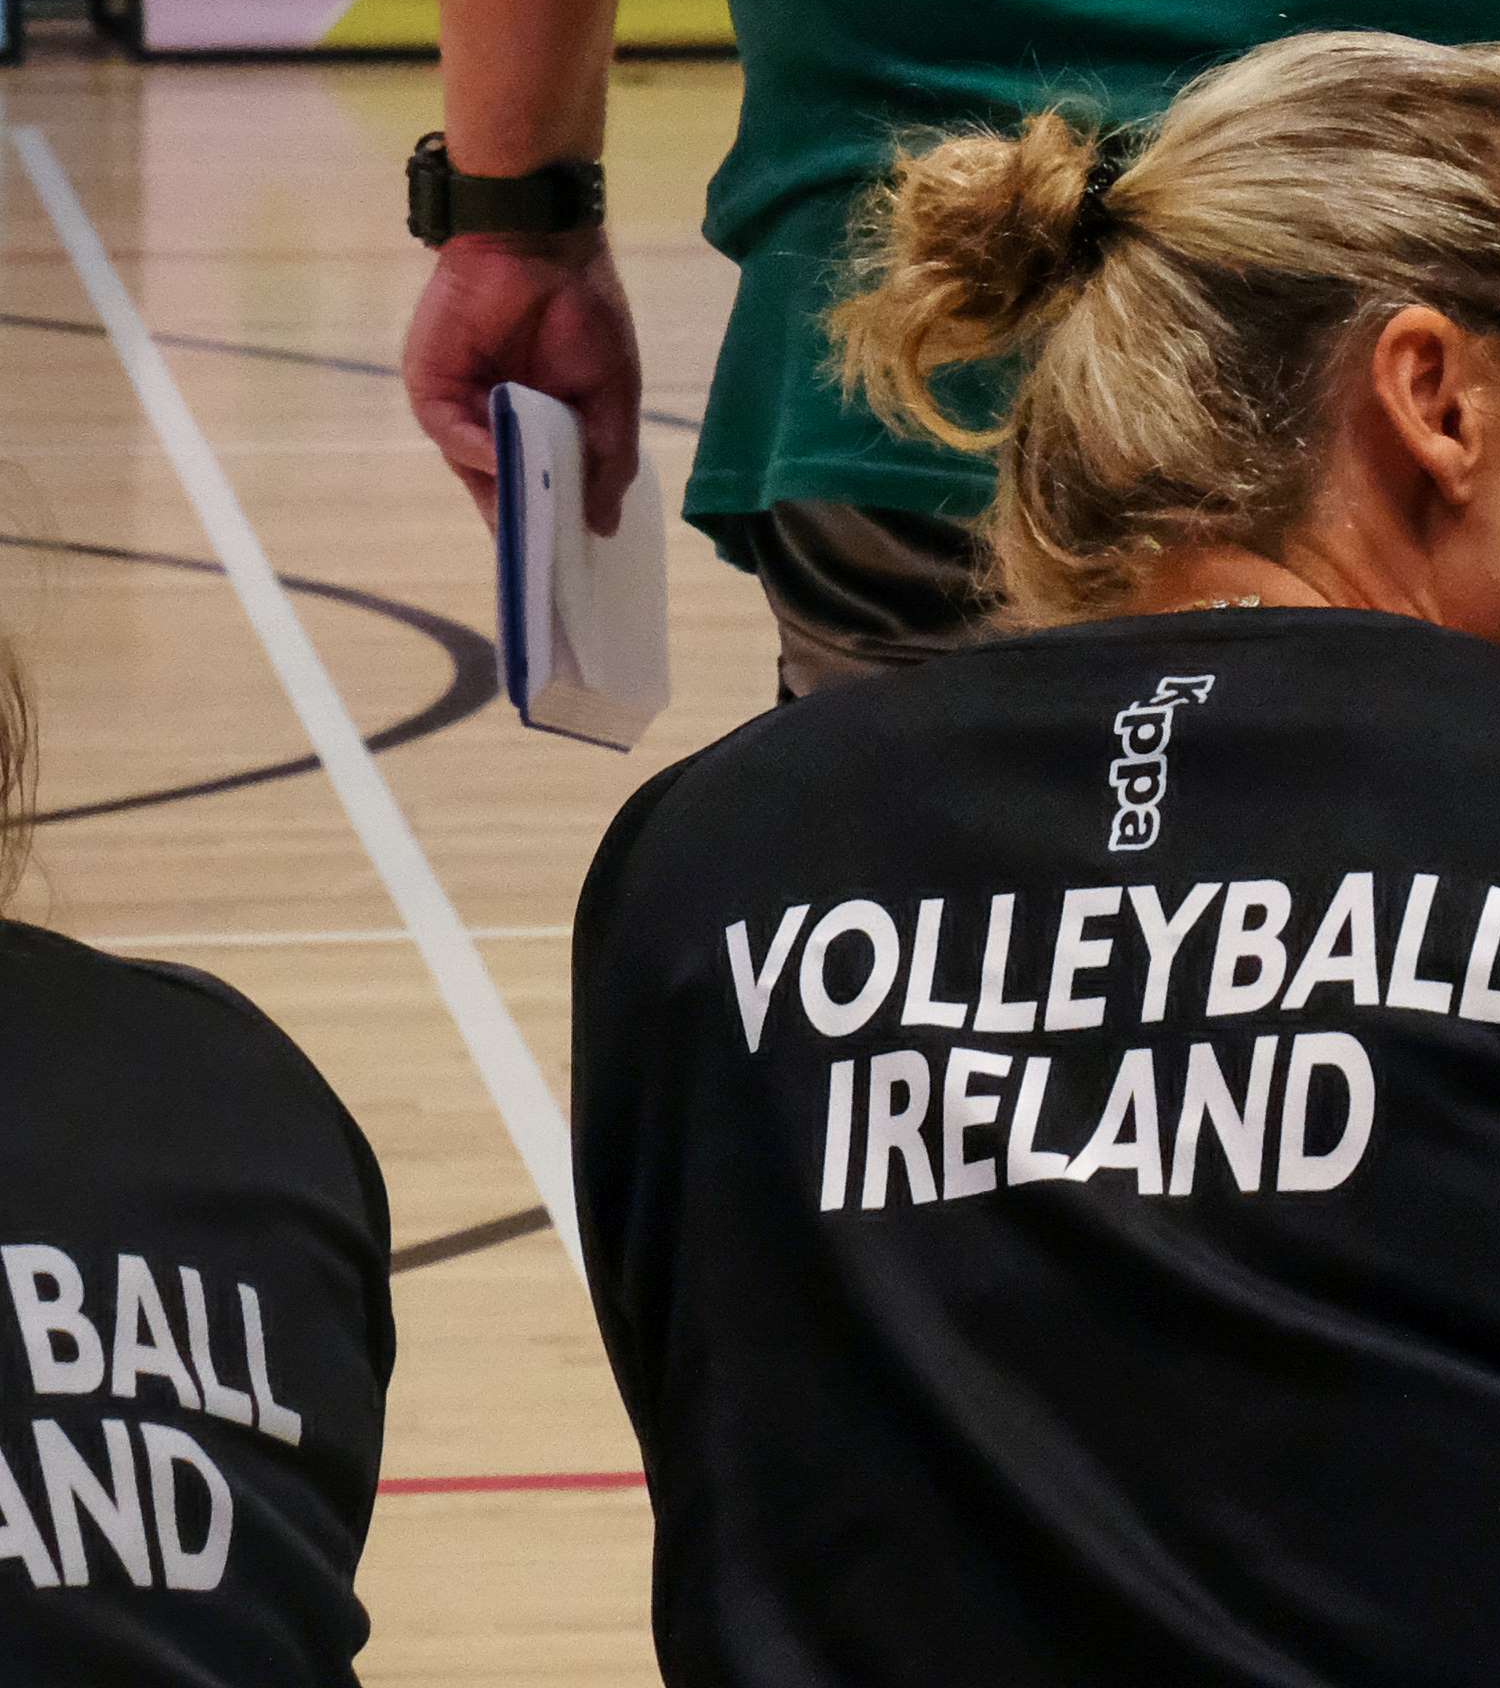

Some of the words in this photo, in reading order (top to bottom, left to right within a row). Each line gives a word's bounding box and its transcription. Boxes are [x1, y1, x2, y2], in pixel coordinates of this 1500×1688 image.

[1108, 674, 1216, 852] Kppa
[819, 1032, 1375, 1213] IRELAND
[0, 1243, 302, 1447] BALL
[0, 1418, 234, 1591] AND
